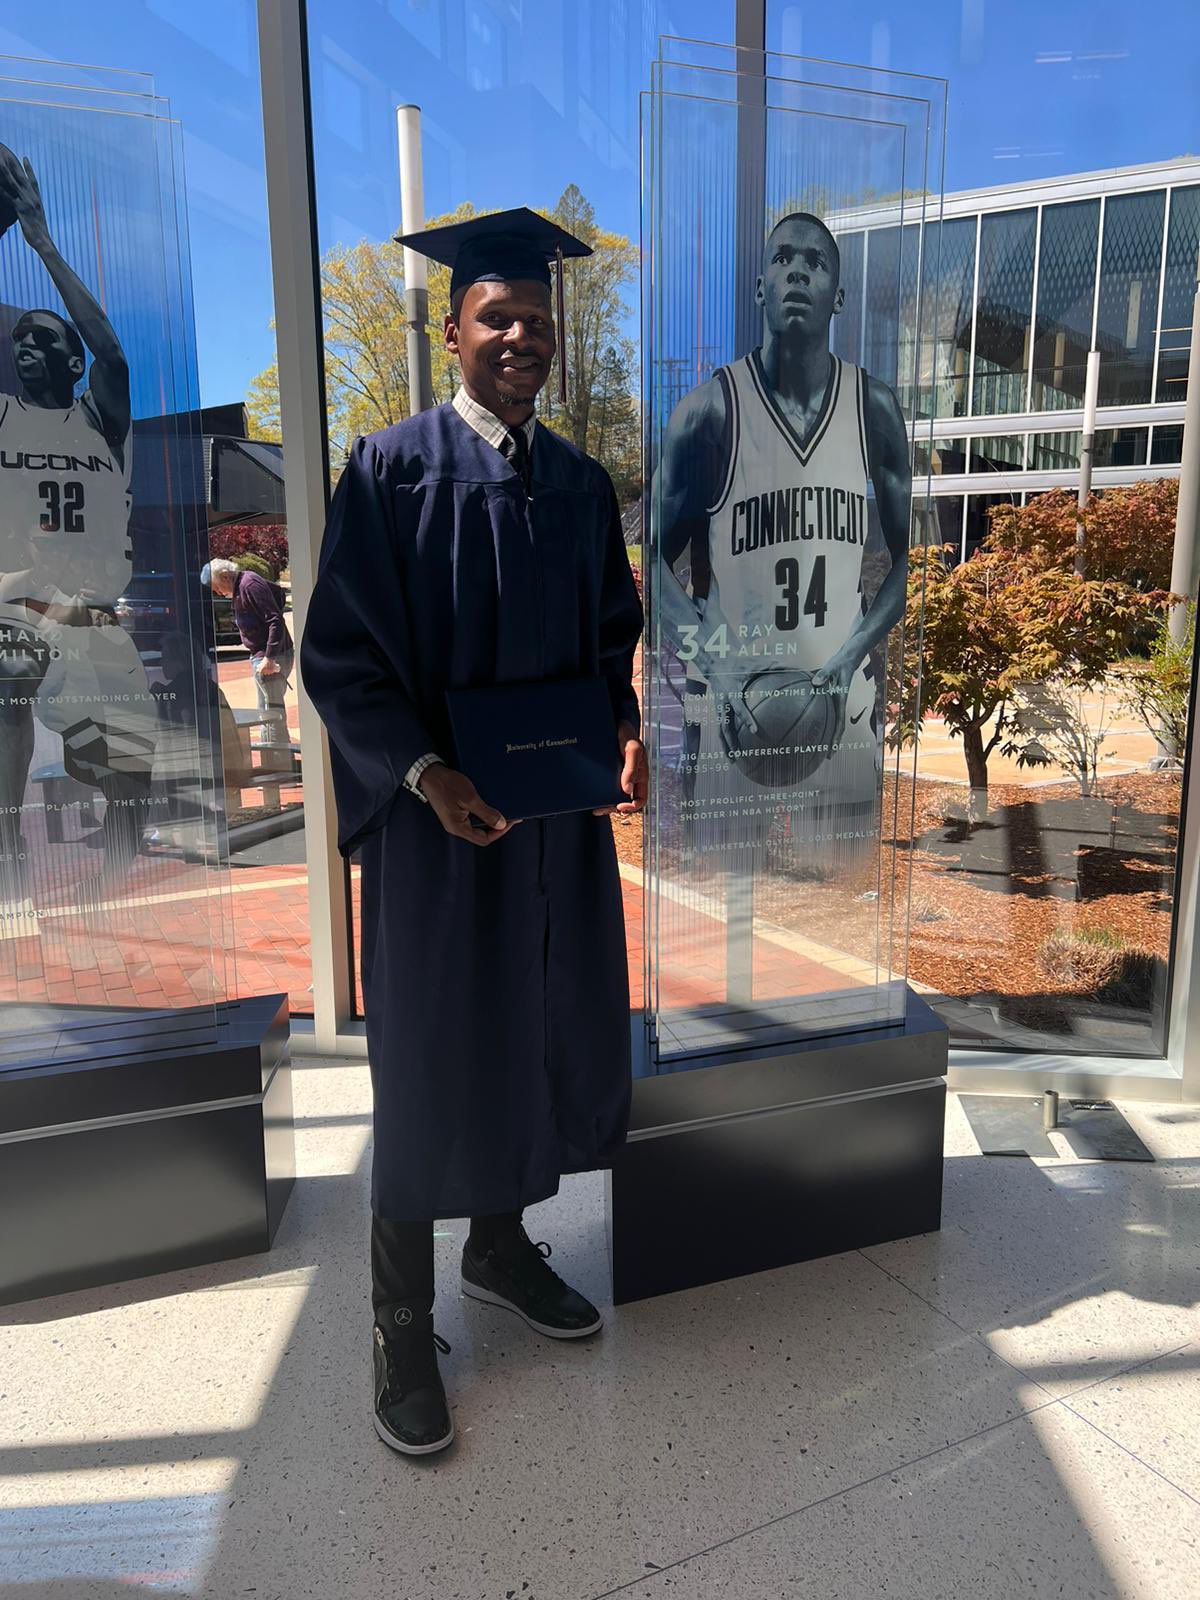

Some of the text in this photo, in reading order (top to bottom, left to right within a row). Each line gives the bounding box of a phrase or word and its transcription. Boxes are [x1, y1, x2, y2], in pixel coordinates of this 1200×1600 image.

[0, 450, 113, 472] UCONN
[38, 480, 85, 533] 32
[731, 486, 865, 556] CONNECTICUT
[774, 555, 828, 631] 34
[738, 623, 774, 637] RAY
[675, 623, 730, 661] 34
[737, 642, 798, 656] ALLEN
[10, 697, 41, 706] MOST
[47, 694, 130, 704] OUTSTANDING
[134, 692, 177, 702] PLAYER
[728, 690, 754, 700] FIRST
[759, 687, 806, 698] TWO-TIME
[680, 741, 871, 761] BIG EAST CONFERENCE PLAYER OF YEAR
[681, 762, 730, 774] 1995-96
[114, 798, 135, 807] THE
[140, 797, 169, 806] YEAR
[680, 790, 820, 808] MOST PROLIFIC THREE-POINT
[680, 804, 805, 821] SHOOTER IN NBA HISTORY
[836, 829, 879, 840] MEDALIST
